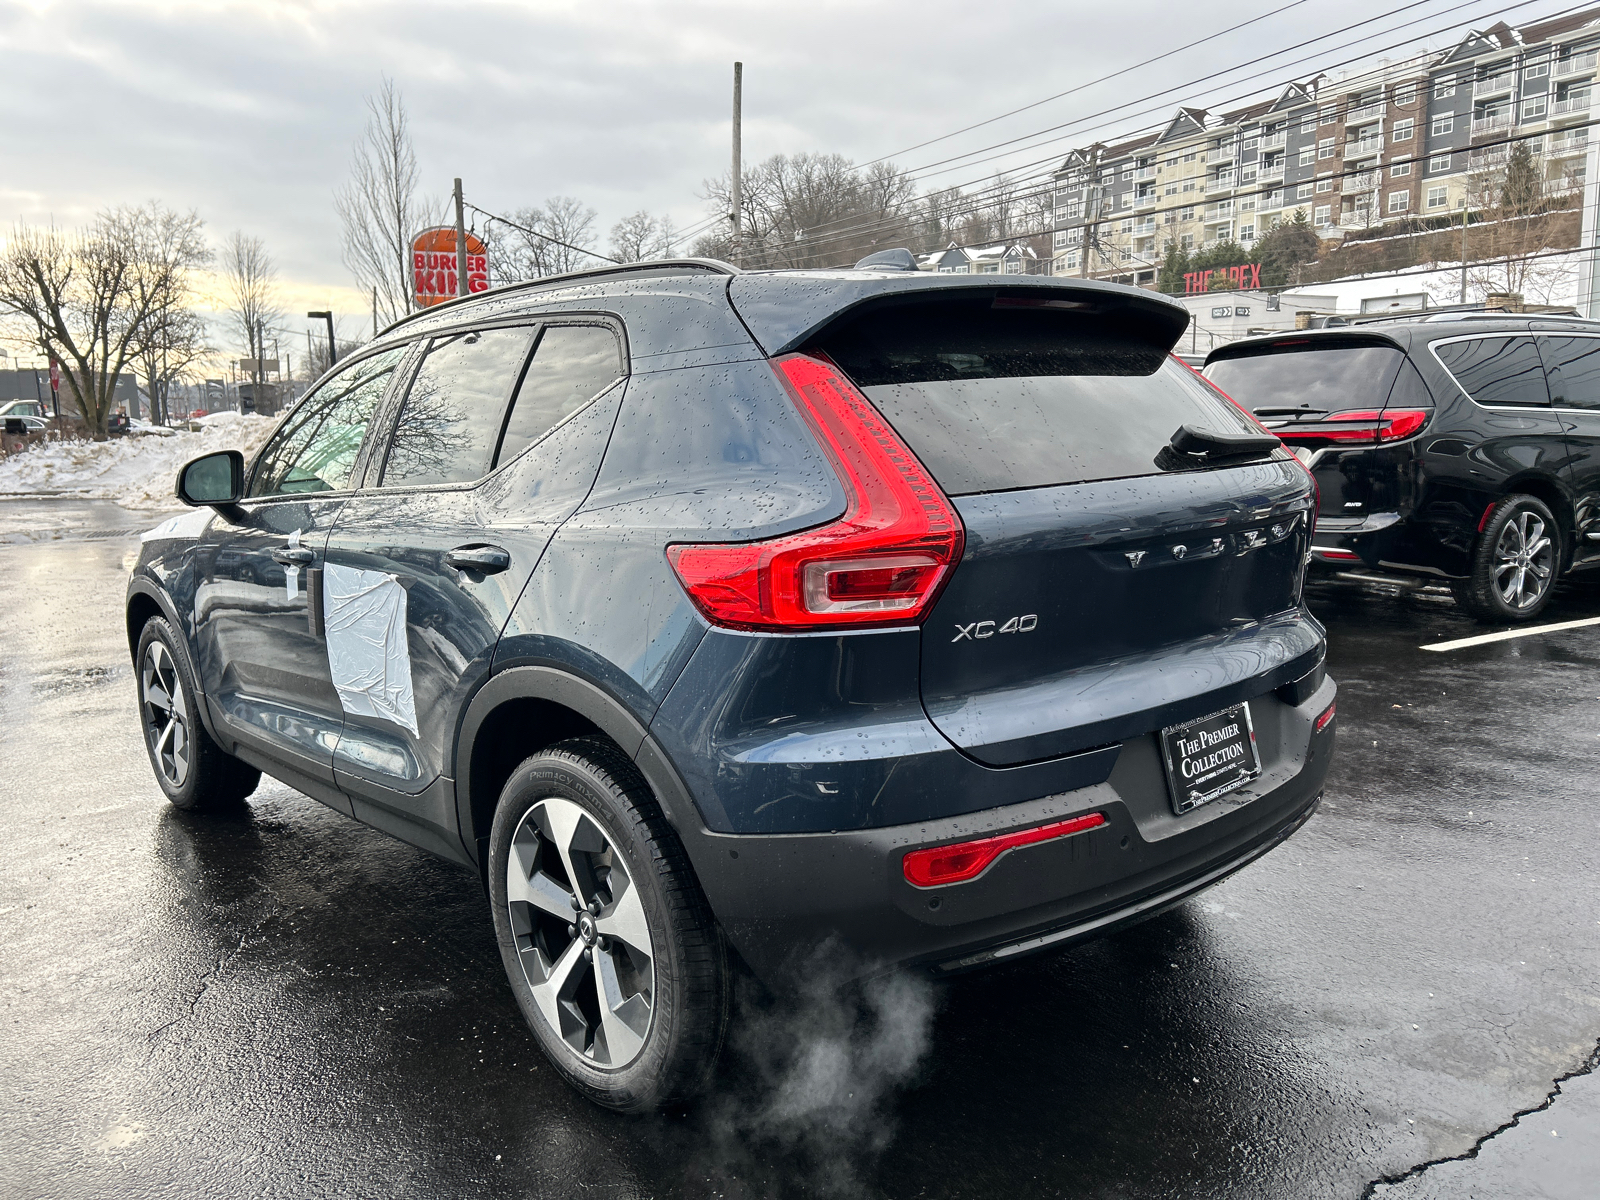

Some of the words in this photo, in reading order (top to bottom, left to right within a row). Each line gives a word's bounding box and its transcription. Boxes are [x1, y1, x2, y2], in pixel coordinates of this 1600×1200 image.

[1124, 523, 1284, 569] VOLVO
[1177, 738, 1201, 758] THE
[1199, 723, 1240, 749] PREMIER
[1181, 741, 1244, 778] COLLECTION
[529, 771, 574, 785] PRIMACY
